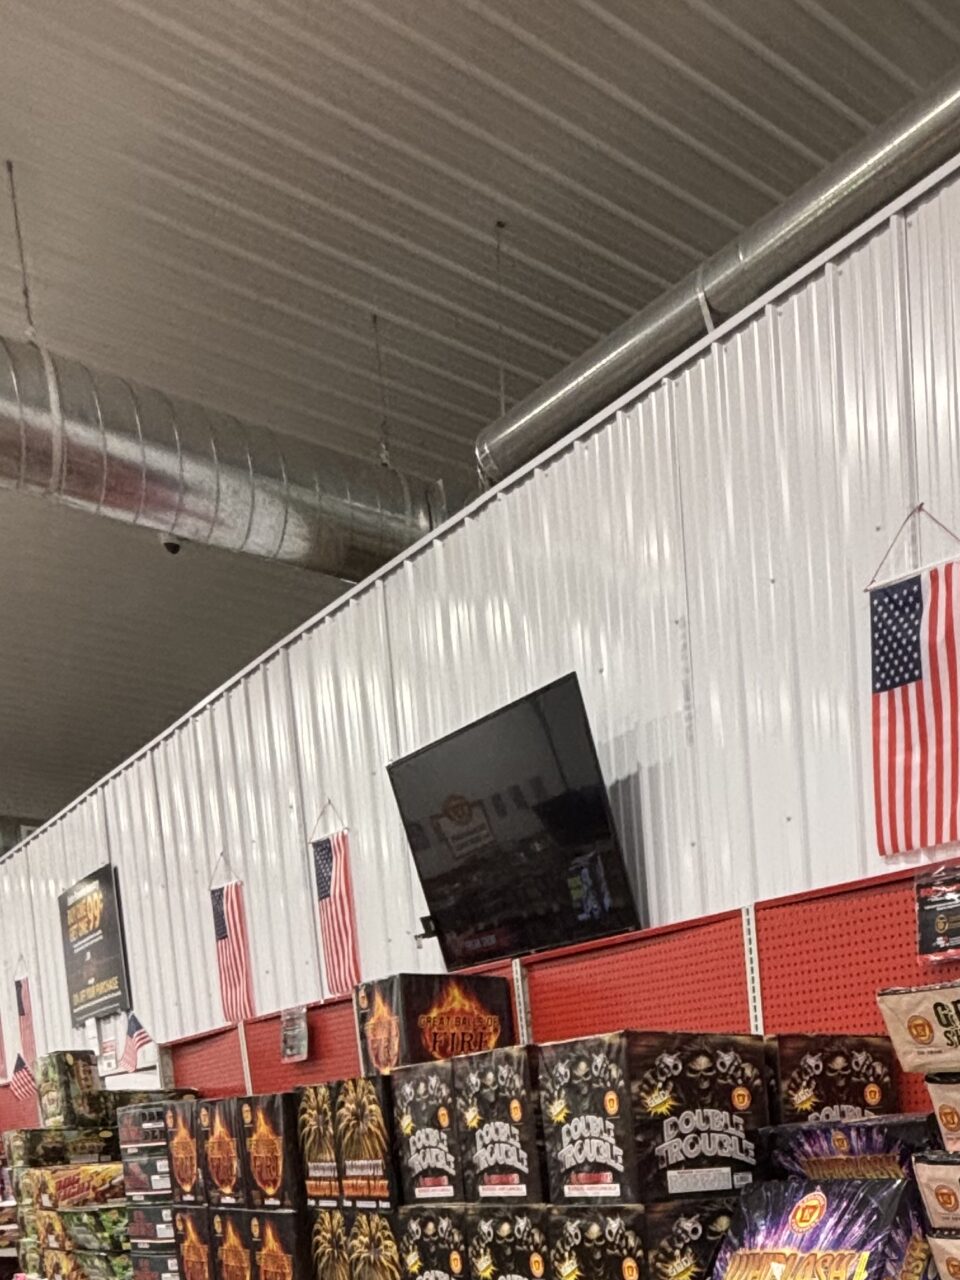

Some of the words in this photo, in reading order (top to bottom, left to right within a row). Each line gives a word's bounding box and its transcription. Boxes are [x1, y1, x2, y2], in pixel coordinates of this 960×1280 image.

[561, 1115, 616, 1148] DOUBLE
[664, 1108, 745, 1143] DOUBLE
[558, 1139, 624, 1173] TROUBLE
[655, 1133, 757, 1169] TROUBLE
